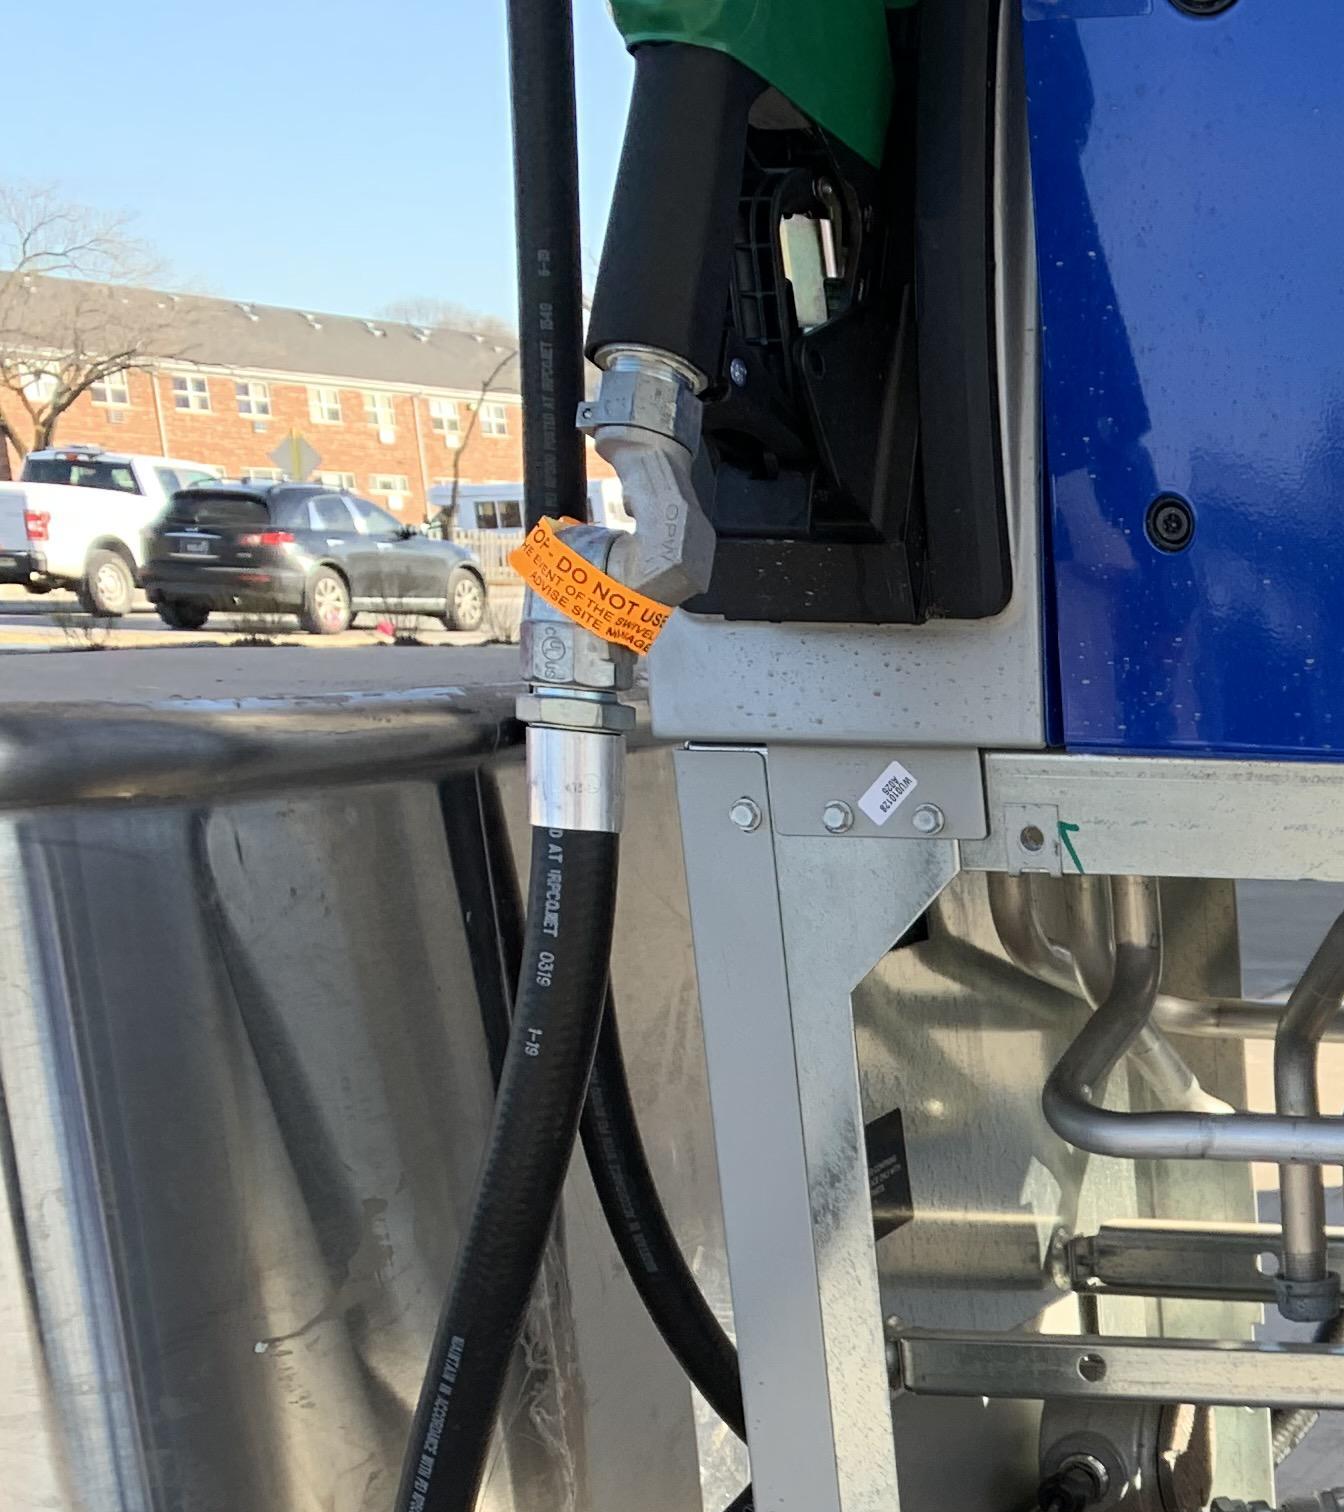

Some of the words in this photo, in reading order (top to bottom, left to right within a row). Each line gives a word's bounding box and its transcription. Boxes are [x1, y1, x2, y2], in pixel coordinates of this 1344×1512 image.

[530, 571, 569, 607] ADVISE
[572, 605, 604, 631] SITE
[556, 556, 588, 584] DO
[592, 581, 639, 615] NOT
[565, 585, 585, 600] OF
[587, 597, 614, 623] THE
[547, 843, 563, 864] AT
[536, 951, 555, 987] 0319
